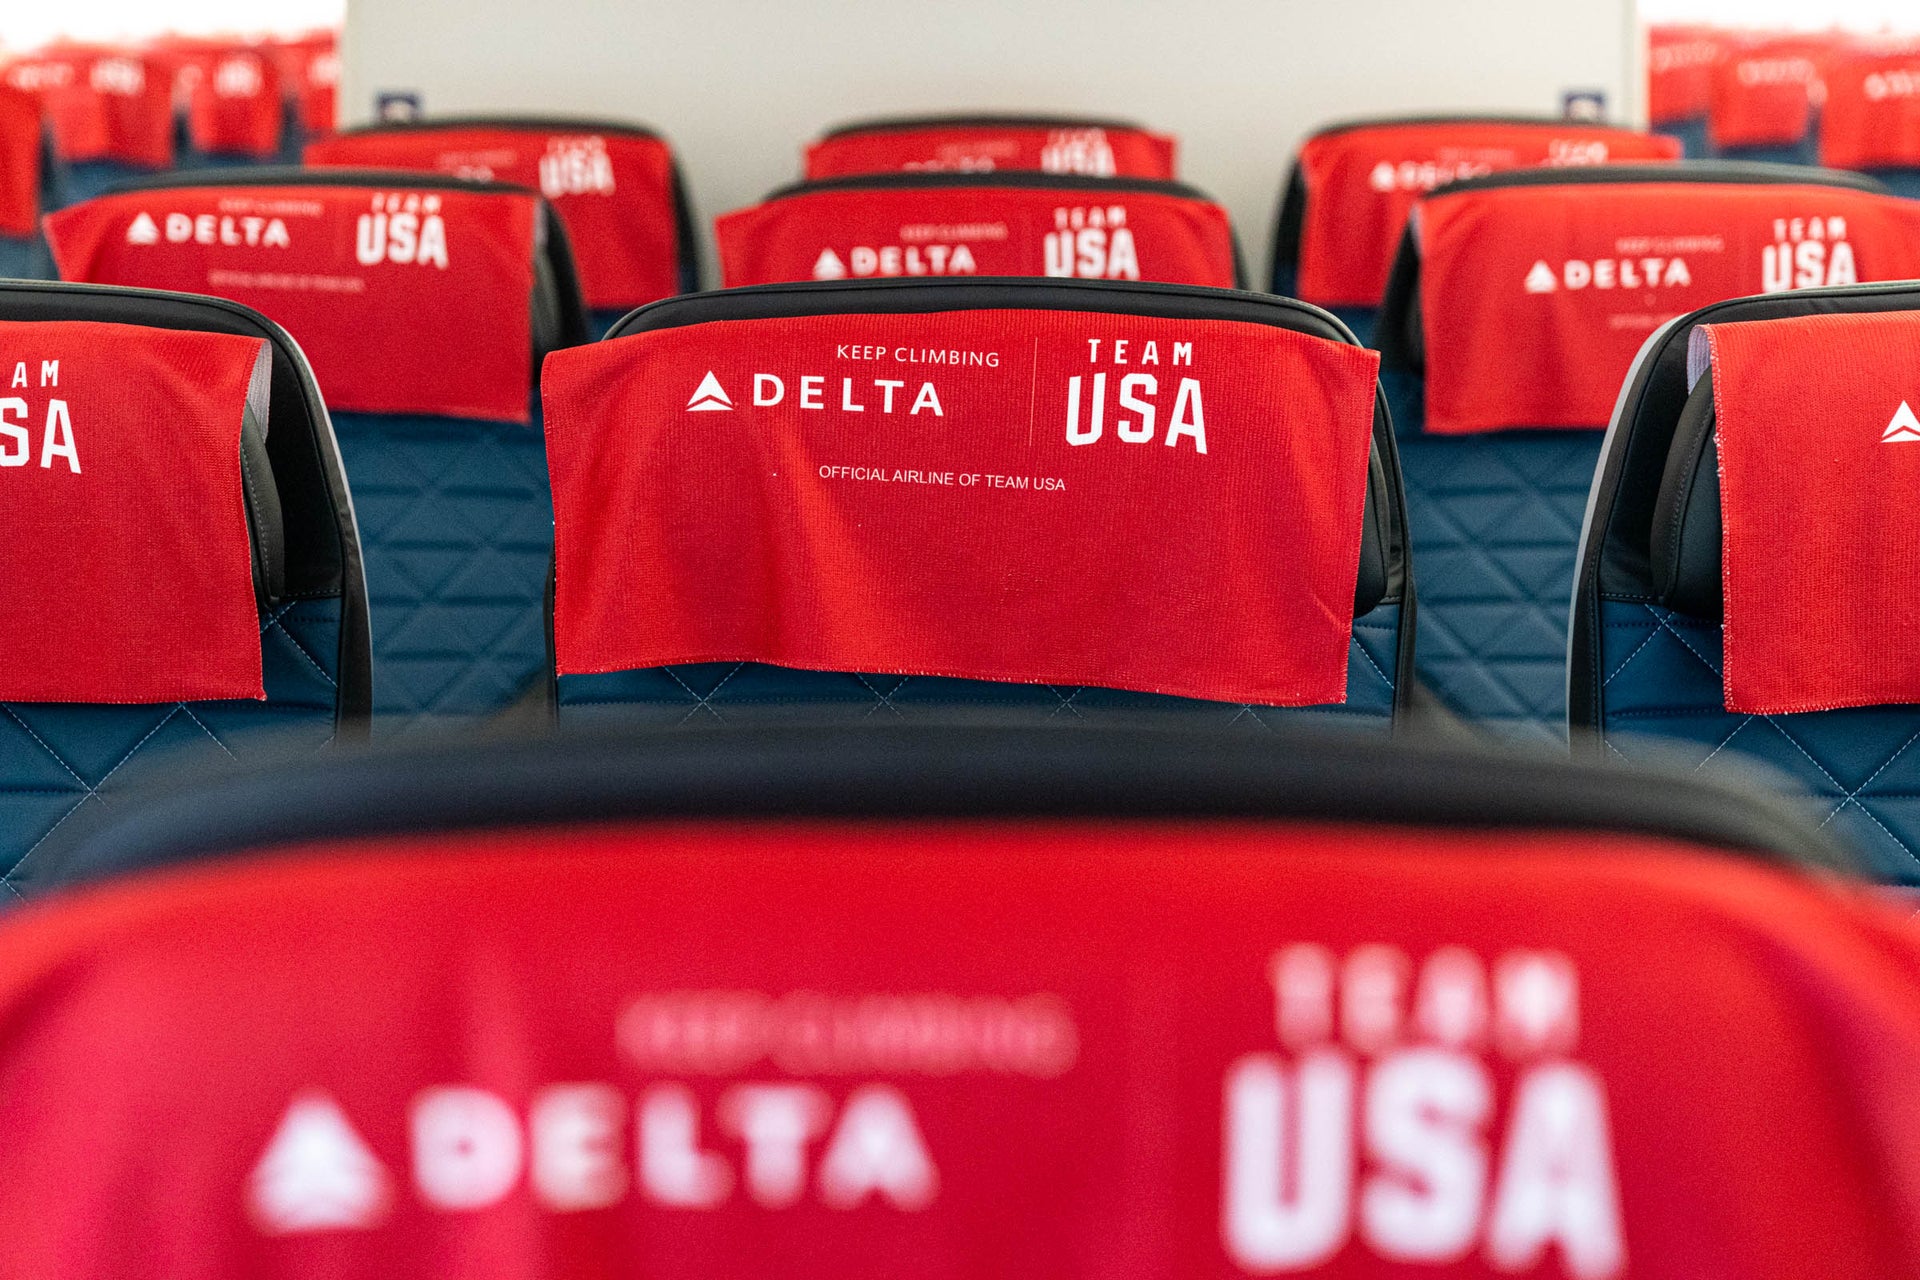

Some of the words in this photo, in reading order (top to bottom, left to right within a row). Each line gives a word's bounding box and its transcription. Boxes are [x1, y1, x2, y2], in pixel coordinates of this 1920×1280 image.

[165, 212, 290, 247] DELTA
[356, 211, 449, 269] USA
[850, 244, 976, 277] DELTA
[1044, 227, 1140, 279] USA
[1563, 257, 1691, 290] DELTA
[1762, 239, 1858, 293] USA
[837, 344, 887, 361] KEEP
[894, 346, 999, 368] CLIMBING
[1087, 338, 1193, 366] TEAM
[753, 373, 944, 417] DELTA
[1065, 372, 1208, 455] USA
[818, 465, 890, 482] OFFICIAL
[892, 469, 954, 486] AIRLINE
[958, 473, 980, 487] OF
[984, 474, 1029, 489] TEAM
[1033, 477, 1066, 491] USA
[411, 1085, 932, 1210] DELTA
[1226, 1046, 1622, 1279] USA
